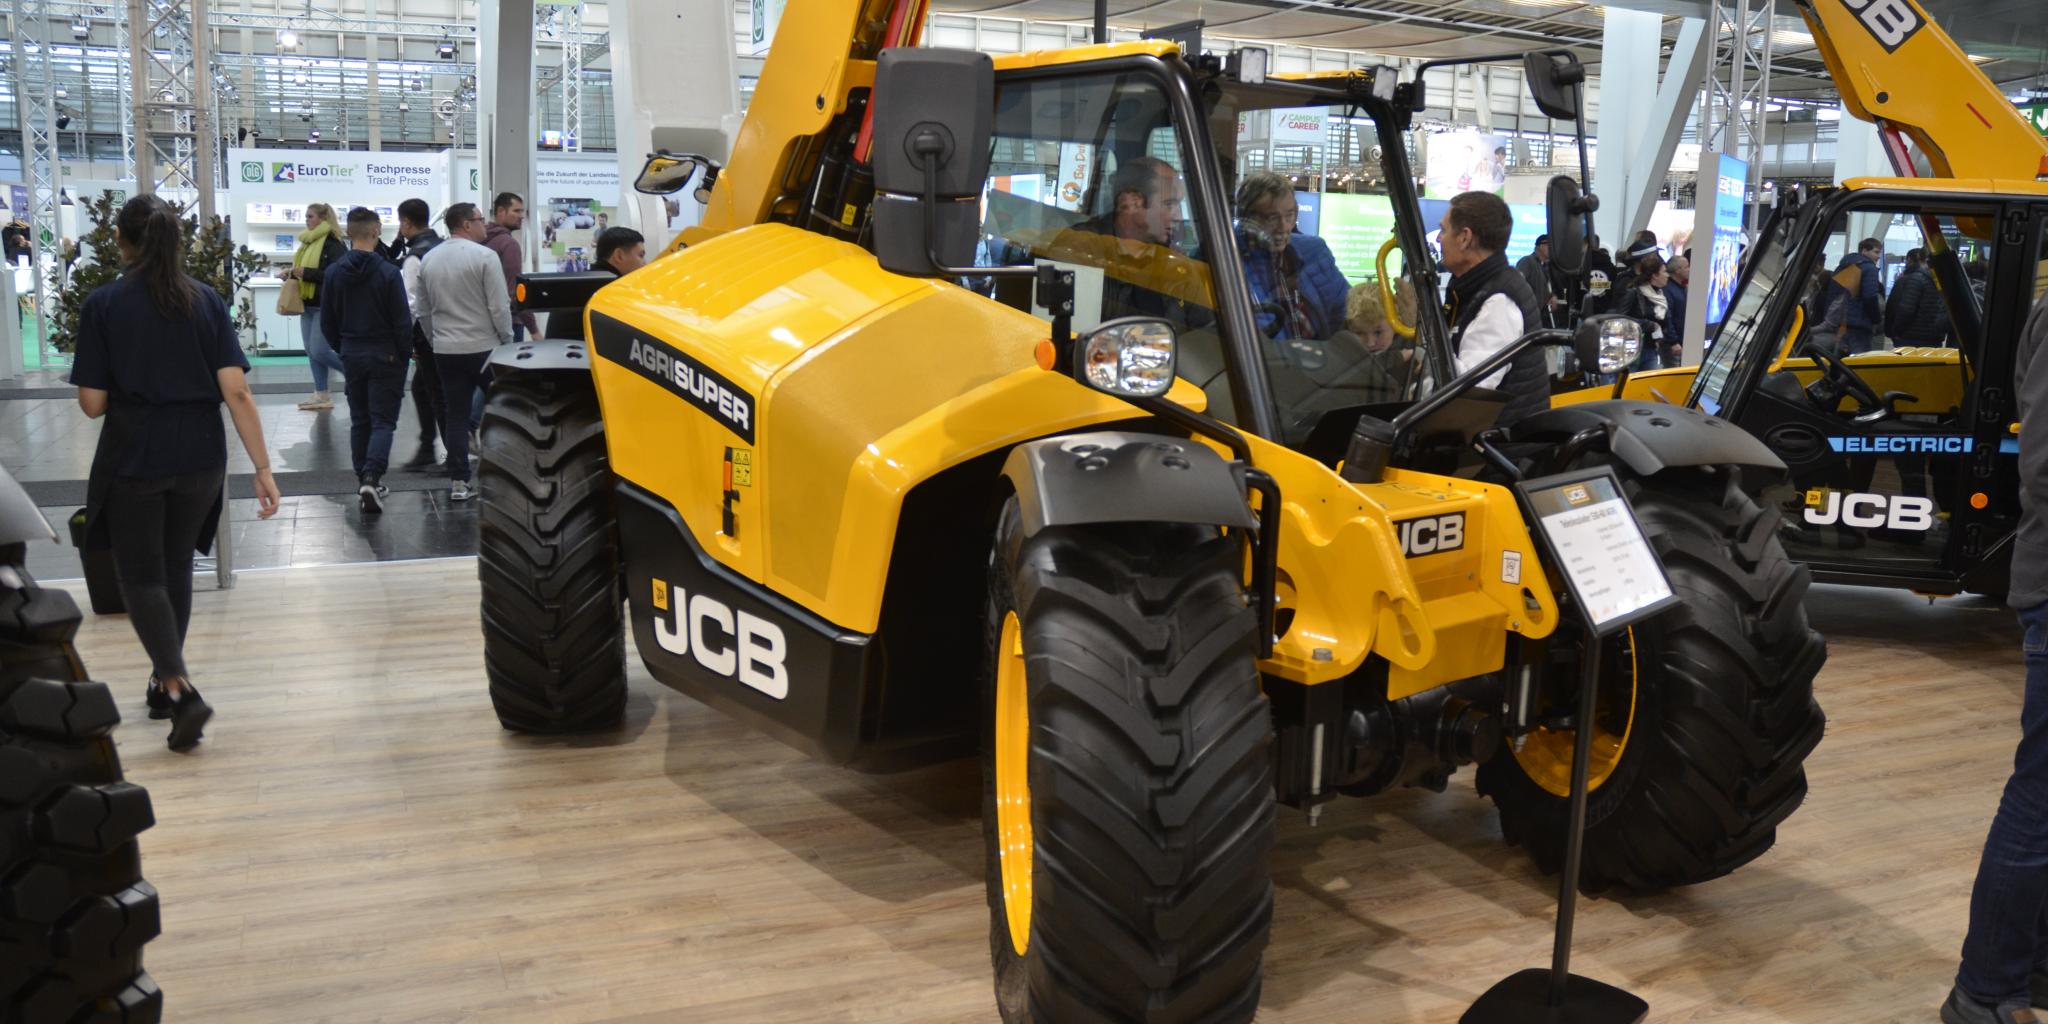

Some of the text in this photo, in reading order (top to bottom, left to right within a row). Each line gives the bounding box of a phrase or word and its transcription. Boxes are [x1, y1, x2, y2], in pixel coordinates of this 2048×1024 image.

[1288, 114, 1320, 123] CAMPUS
[1288, 122, 1319, 131] CAREER
[298, 164, 354, 177] EuroTier
[367, 164, 431, 175] Fachpresse
[368, 175, 429, 186] Trade Press
[629, 338, 749, 430] AGRISUPER
[1845, 437, 1962, 452] ELECTRIC
[1804, 491, 1933, 531] JCB
[1401, 514, 1464, 555] JCB
[654, 585, 789, 700] JCB
